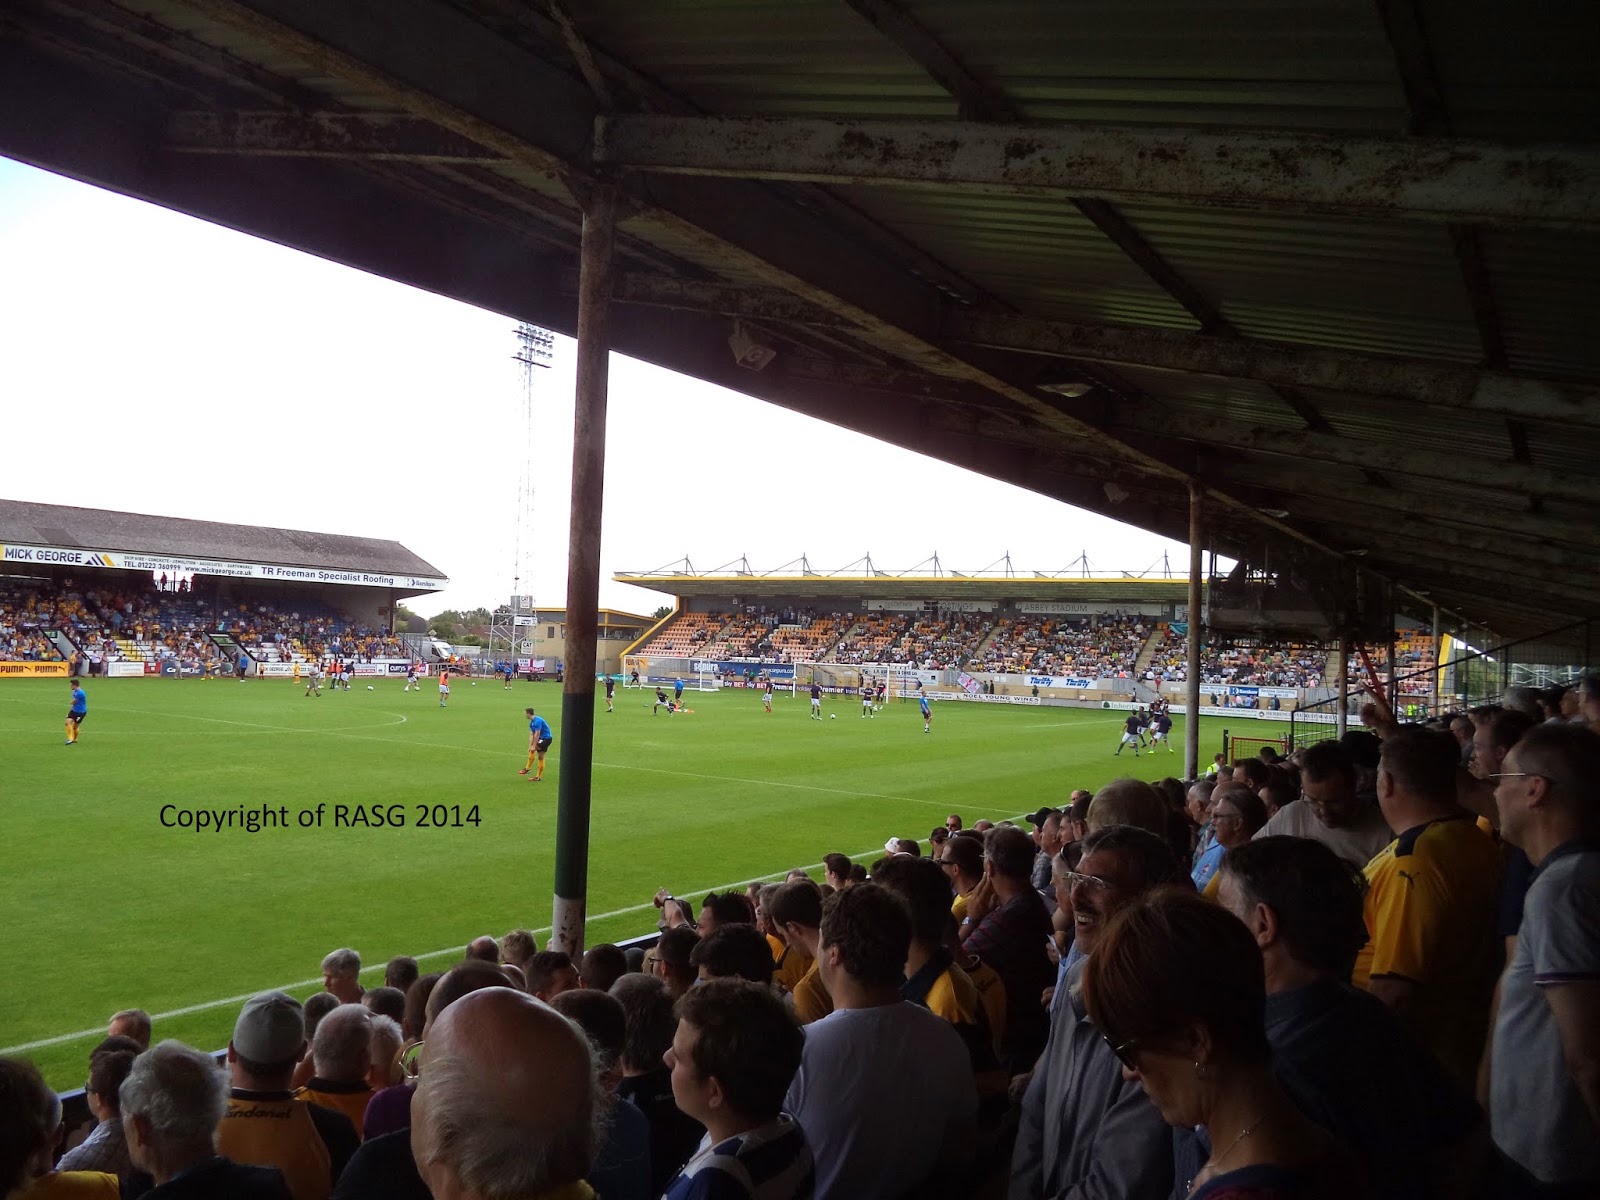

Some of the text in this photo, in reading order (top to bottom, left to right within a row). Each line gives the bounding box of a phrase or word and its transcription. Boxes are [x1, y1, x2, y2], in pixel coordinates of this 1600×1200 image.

[5, 547, 82, 563] MICK GEORGE
[185, 566, 252, 576] www.mickgeorge.co.uk
[261, 567, 394, 585] TR Freeman Specialist Roofing
[1024, 602, 1088, 612] ABBEY STADIUM
[0, 665, 58, 673] PUMA PUMA
[693, 662, 718, 672] sepura
[1029, 676, 1090, 688] Thrifty Thrifty
